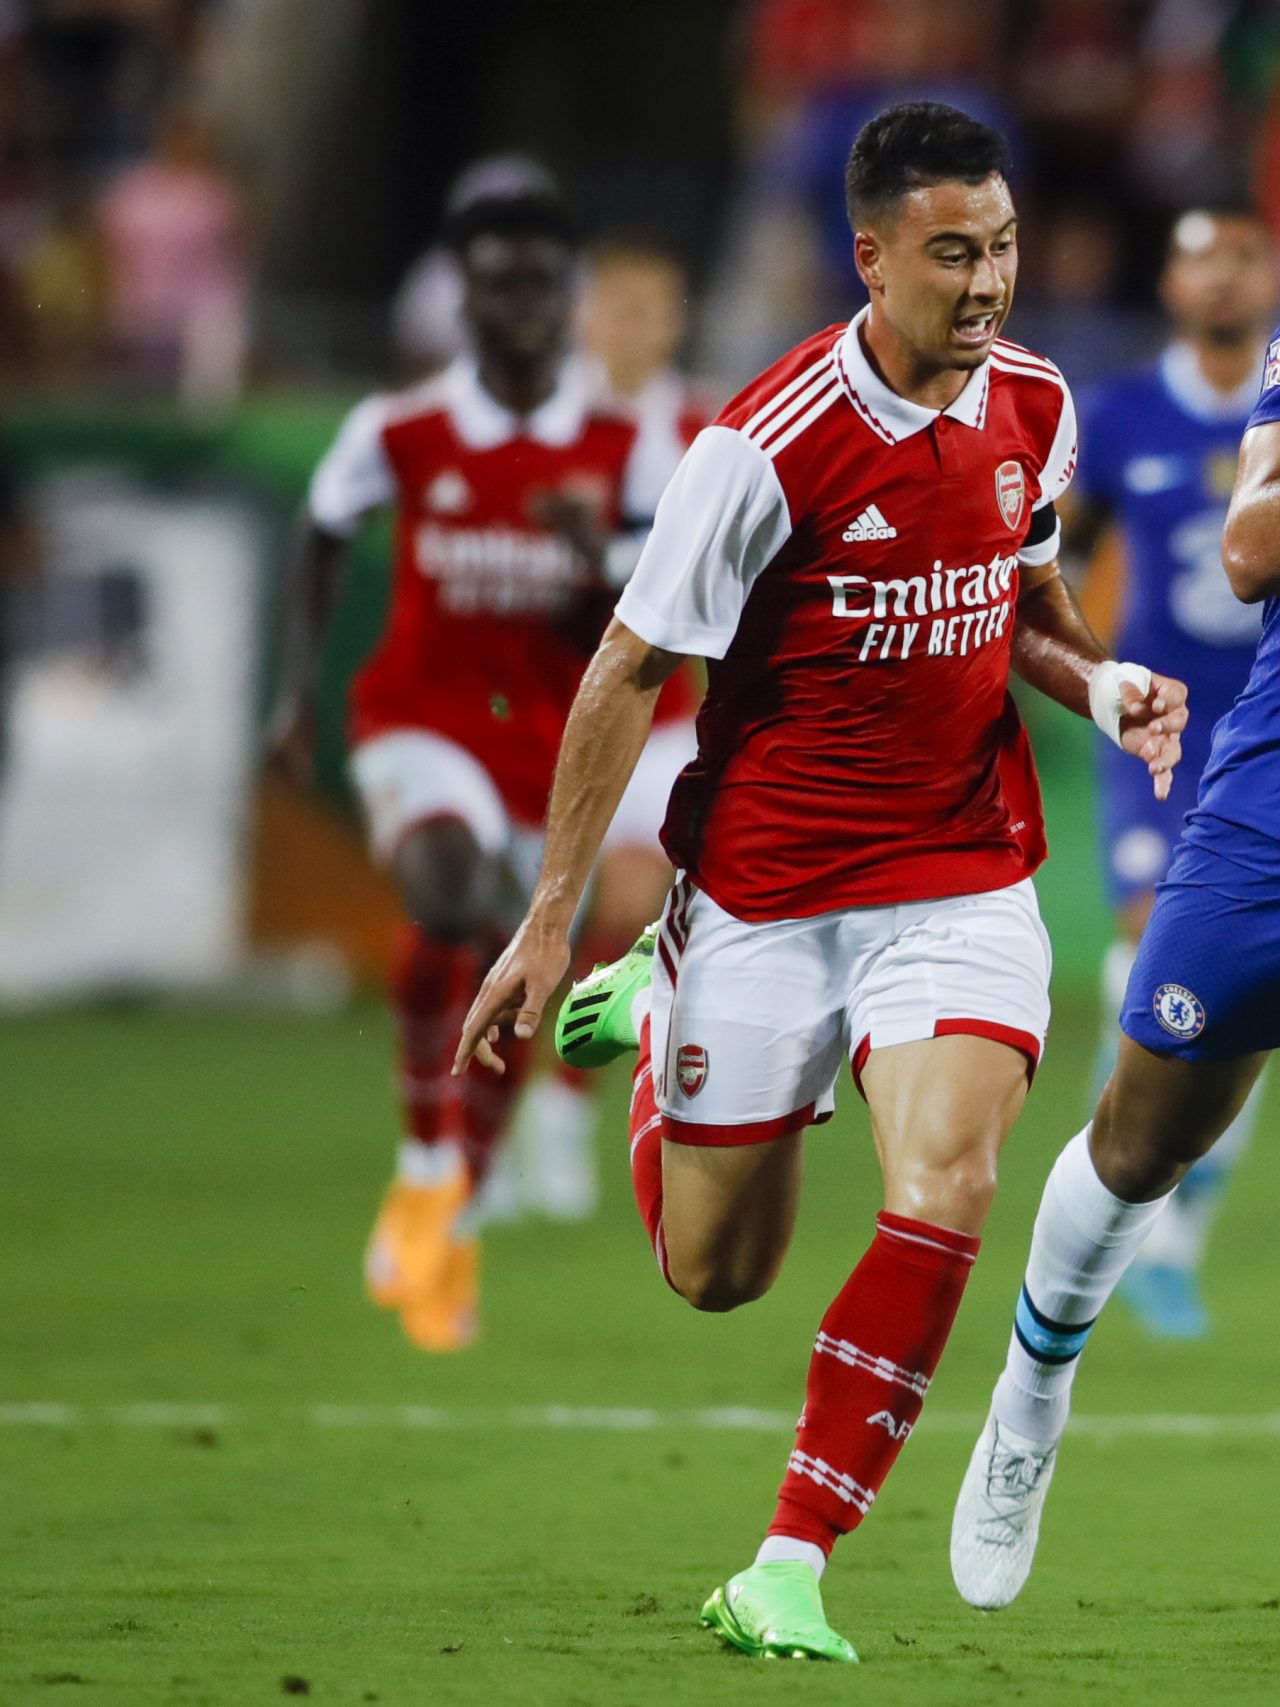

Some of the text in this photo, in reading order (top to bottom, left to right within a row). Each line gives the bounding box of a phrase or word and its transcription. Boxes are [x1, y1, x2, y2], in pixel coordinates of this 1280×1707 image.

[842, 526, 898, 543] adidas
[826, 552, 1019, 618] Emirate
[926, 600, 1010, 657] BETTER
